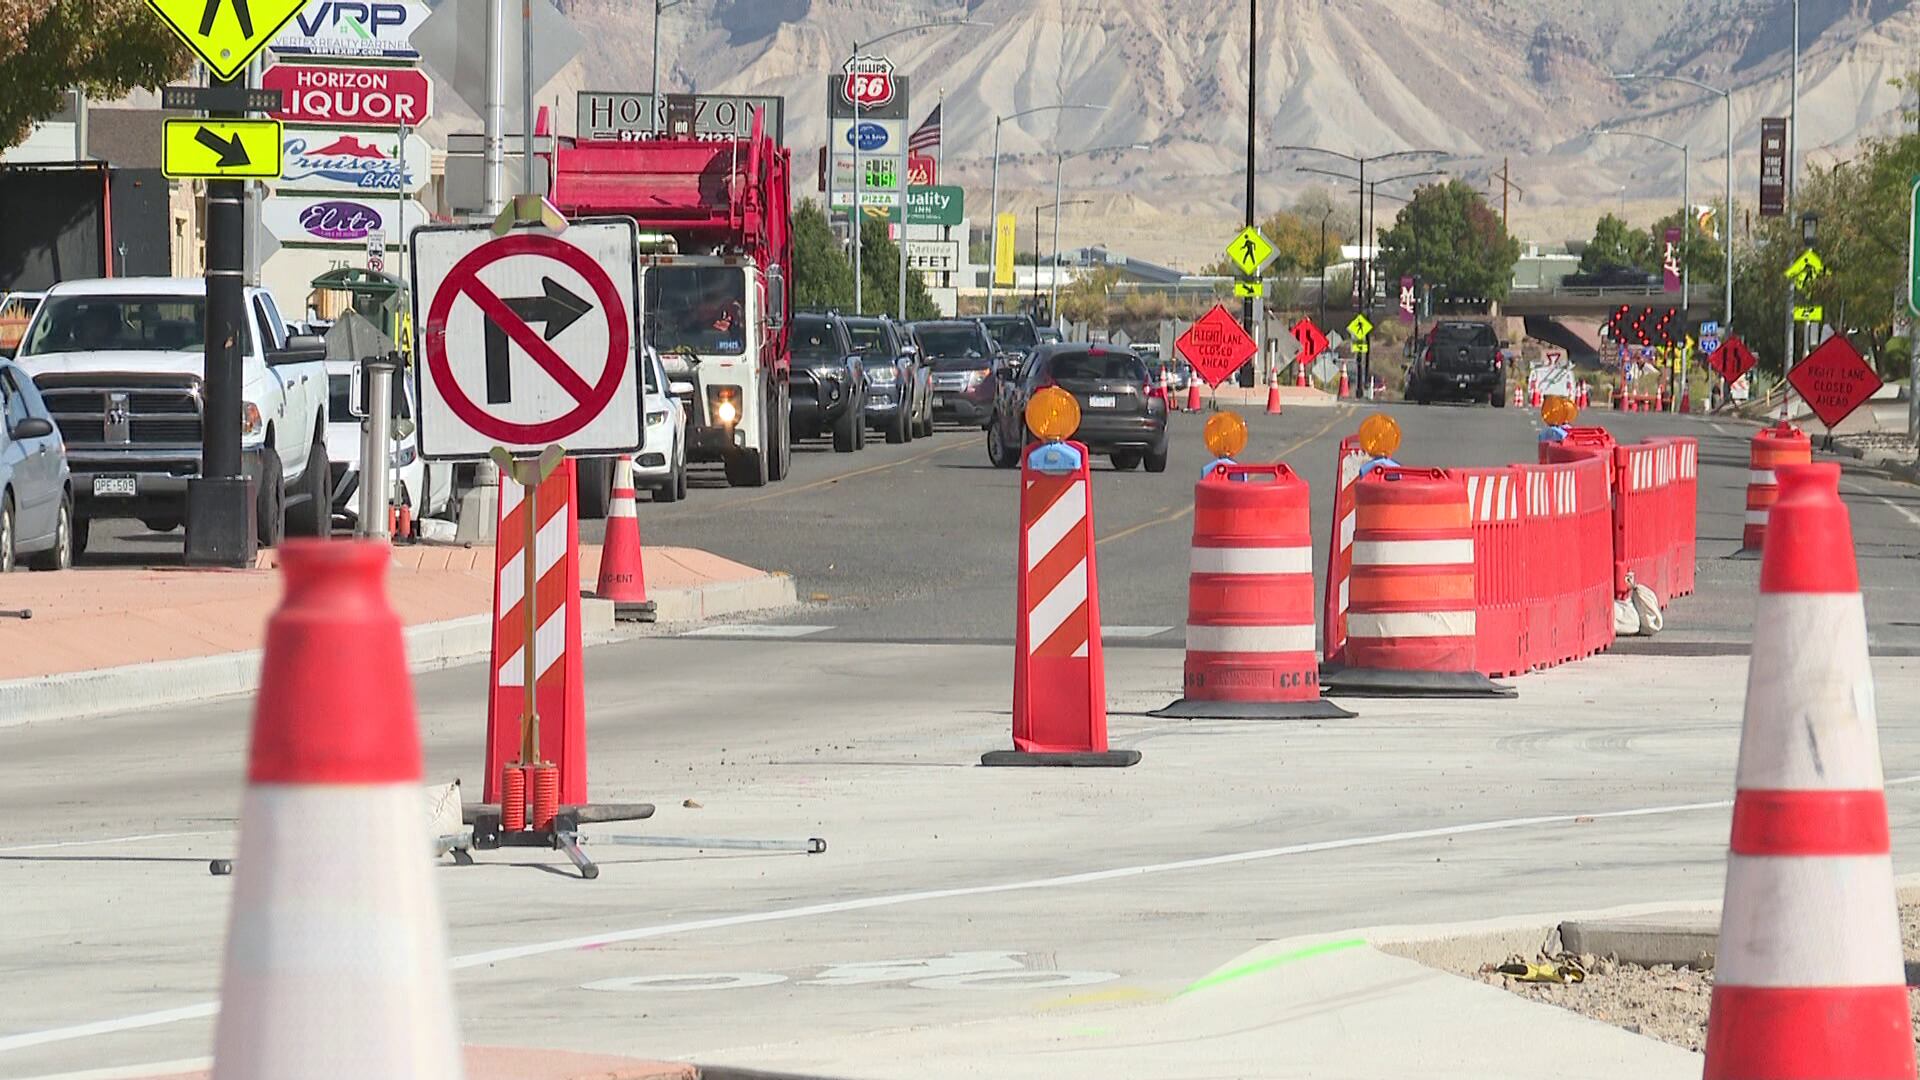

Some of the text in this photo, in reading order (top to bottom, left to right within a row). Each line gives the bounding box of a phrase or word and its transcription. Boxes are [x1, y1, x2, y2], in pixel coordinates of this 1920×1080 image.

[296, 2, 406, 38] VRP
[275, 36, 412, 50] VERTEX REALTY PARTNER
[297, 71, 387, 89] HORIZON
[851, 77, 885, 97] 66
[591, 97, 766, 132] HORZON
[359, 173, 401, 189] BAR
[861, 194, 892, 204] PIZZA
[906, 191, 950, 209] uality
[301, 206, 376, 232] Elite
[328, 260, 350, 271] 715
[907, 255, 951, 267] FFET
[1222, 333, 1243, 345] LANE
[1199, 345, 1233, 357] CLOSED
[1702, 341, 1716, 351] 70
[1201, 357, 1229, 369] AHEAD
[1808, 366, 1866, 381] RIGHT LANE
[1814, 381, 1853, 394] CLOSED
[1816, 395, 1849, 407] AHEAD
